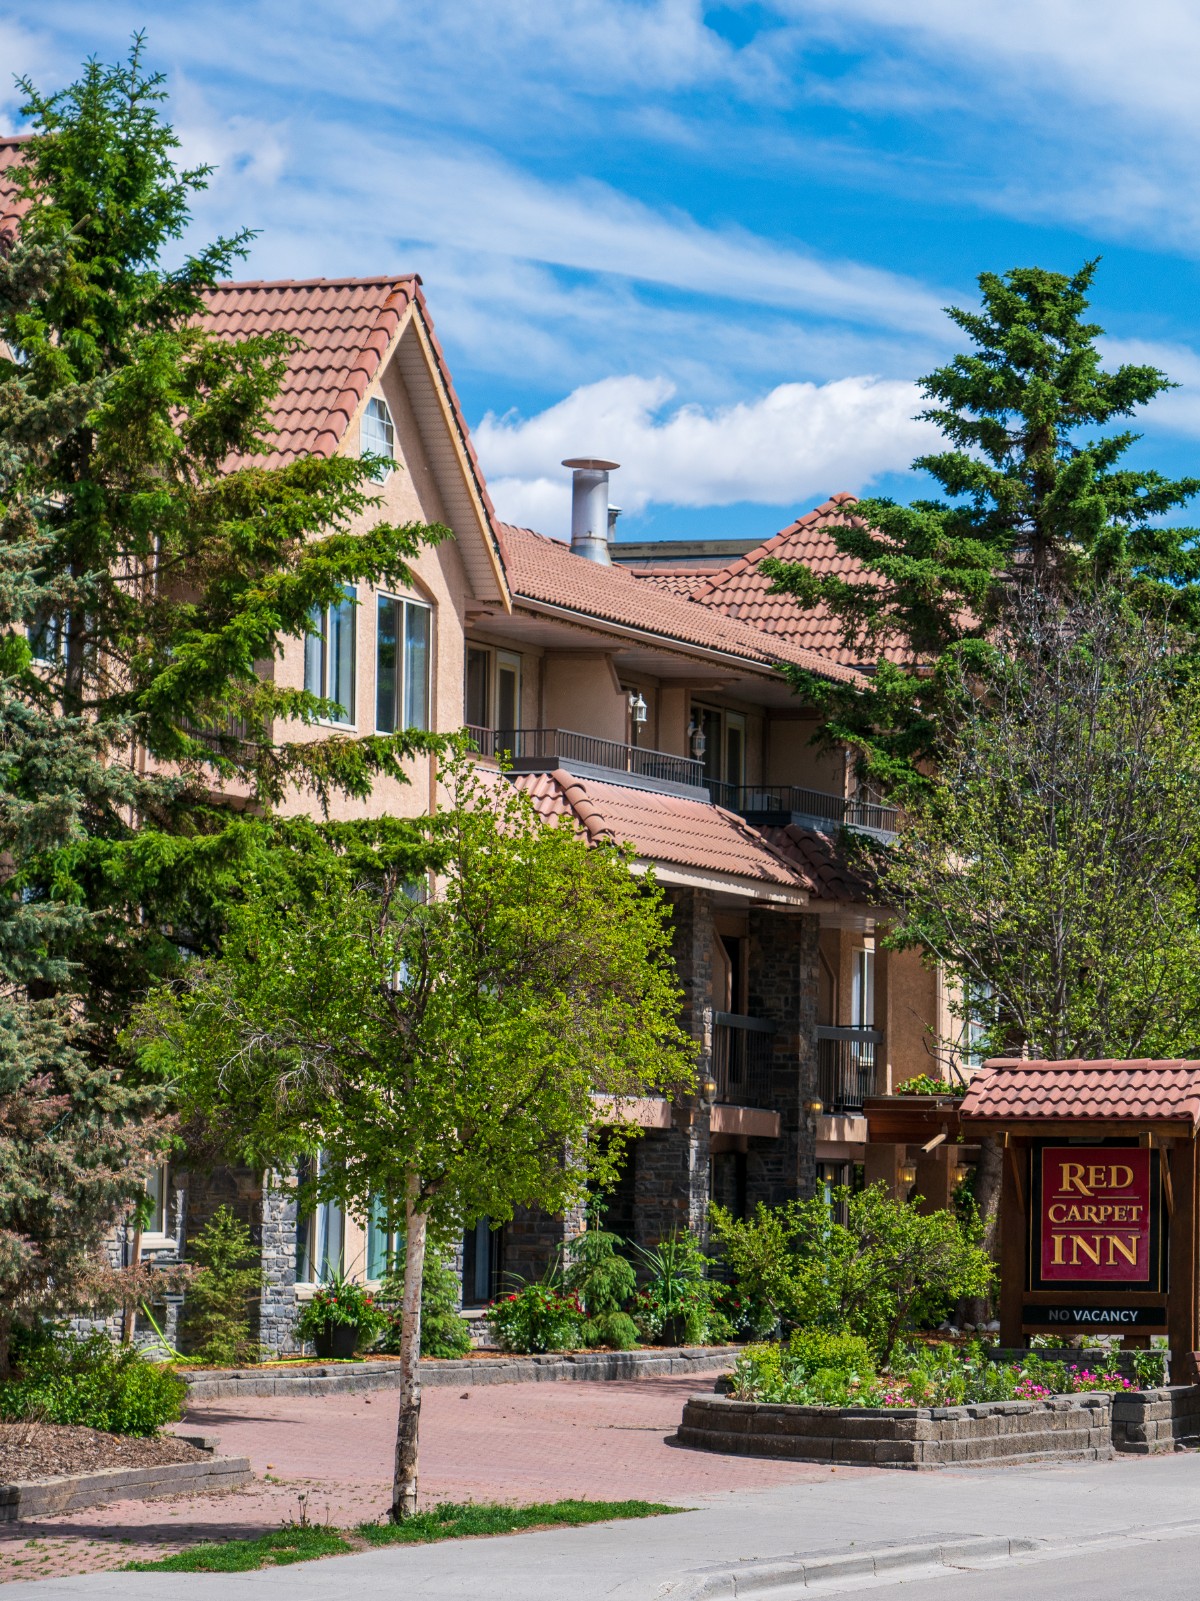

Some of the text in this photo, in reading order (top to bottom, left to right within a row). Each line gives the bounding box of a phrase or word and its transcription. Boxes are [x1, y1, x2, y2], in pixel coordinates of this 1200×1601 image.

[1058, 1162, 1134, 1196] RED
[1048, 1204, 1143, 1224] CARPET
[1050, 1234, 1141, 1266] INN
[1048, 1309, 1139, 1322] NO VACANCY
